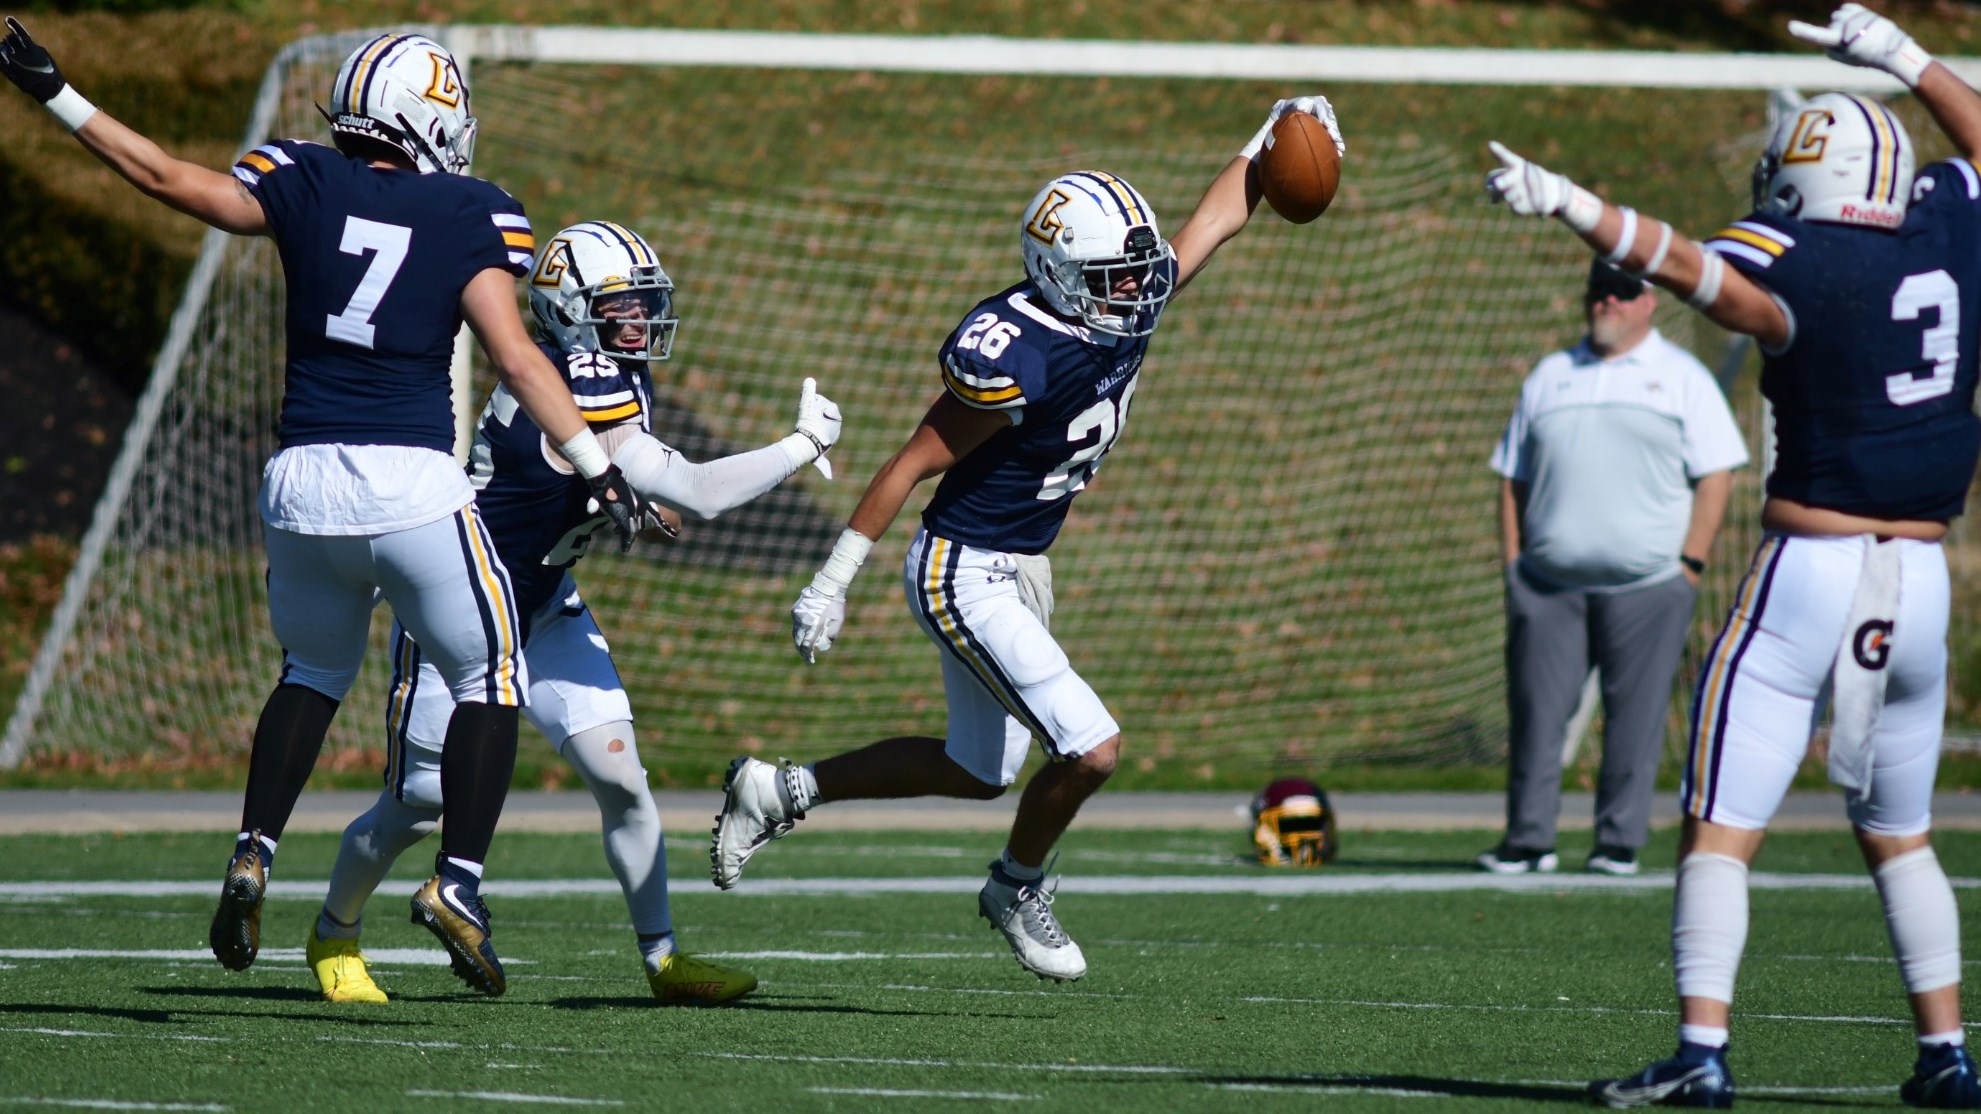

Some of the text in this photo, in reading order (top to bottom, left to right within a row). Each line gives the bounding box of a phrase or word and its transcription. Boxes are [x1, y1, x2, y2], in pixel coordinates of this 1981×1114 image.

[337, 113, 375, 129] schutt
[1025, 187, 1073, 247] L
[325, 214, 413, 351] 7
[957, 312, 1021, 360] 26
[1885, 269, 1960, 407] 3
[566, 351, 620, 380] 25
[1853, 618, 1895, 671] G
